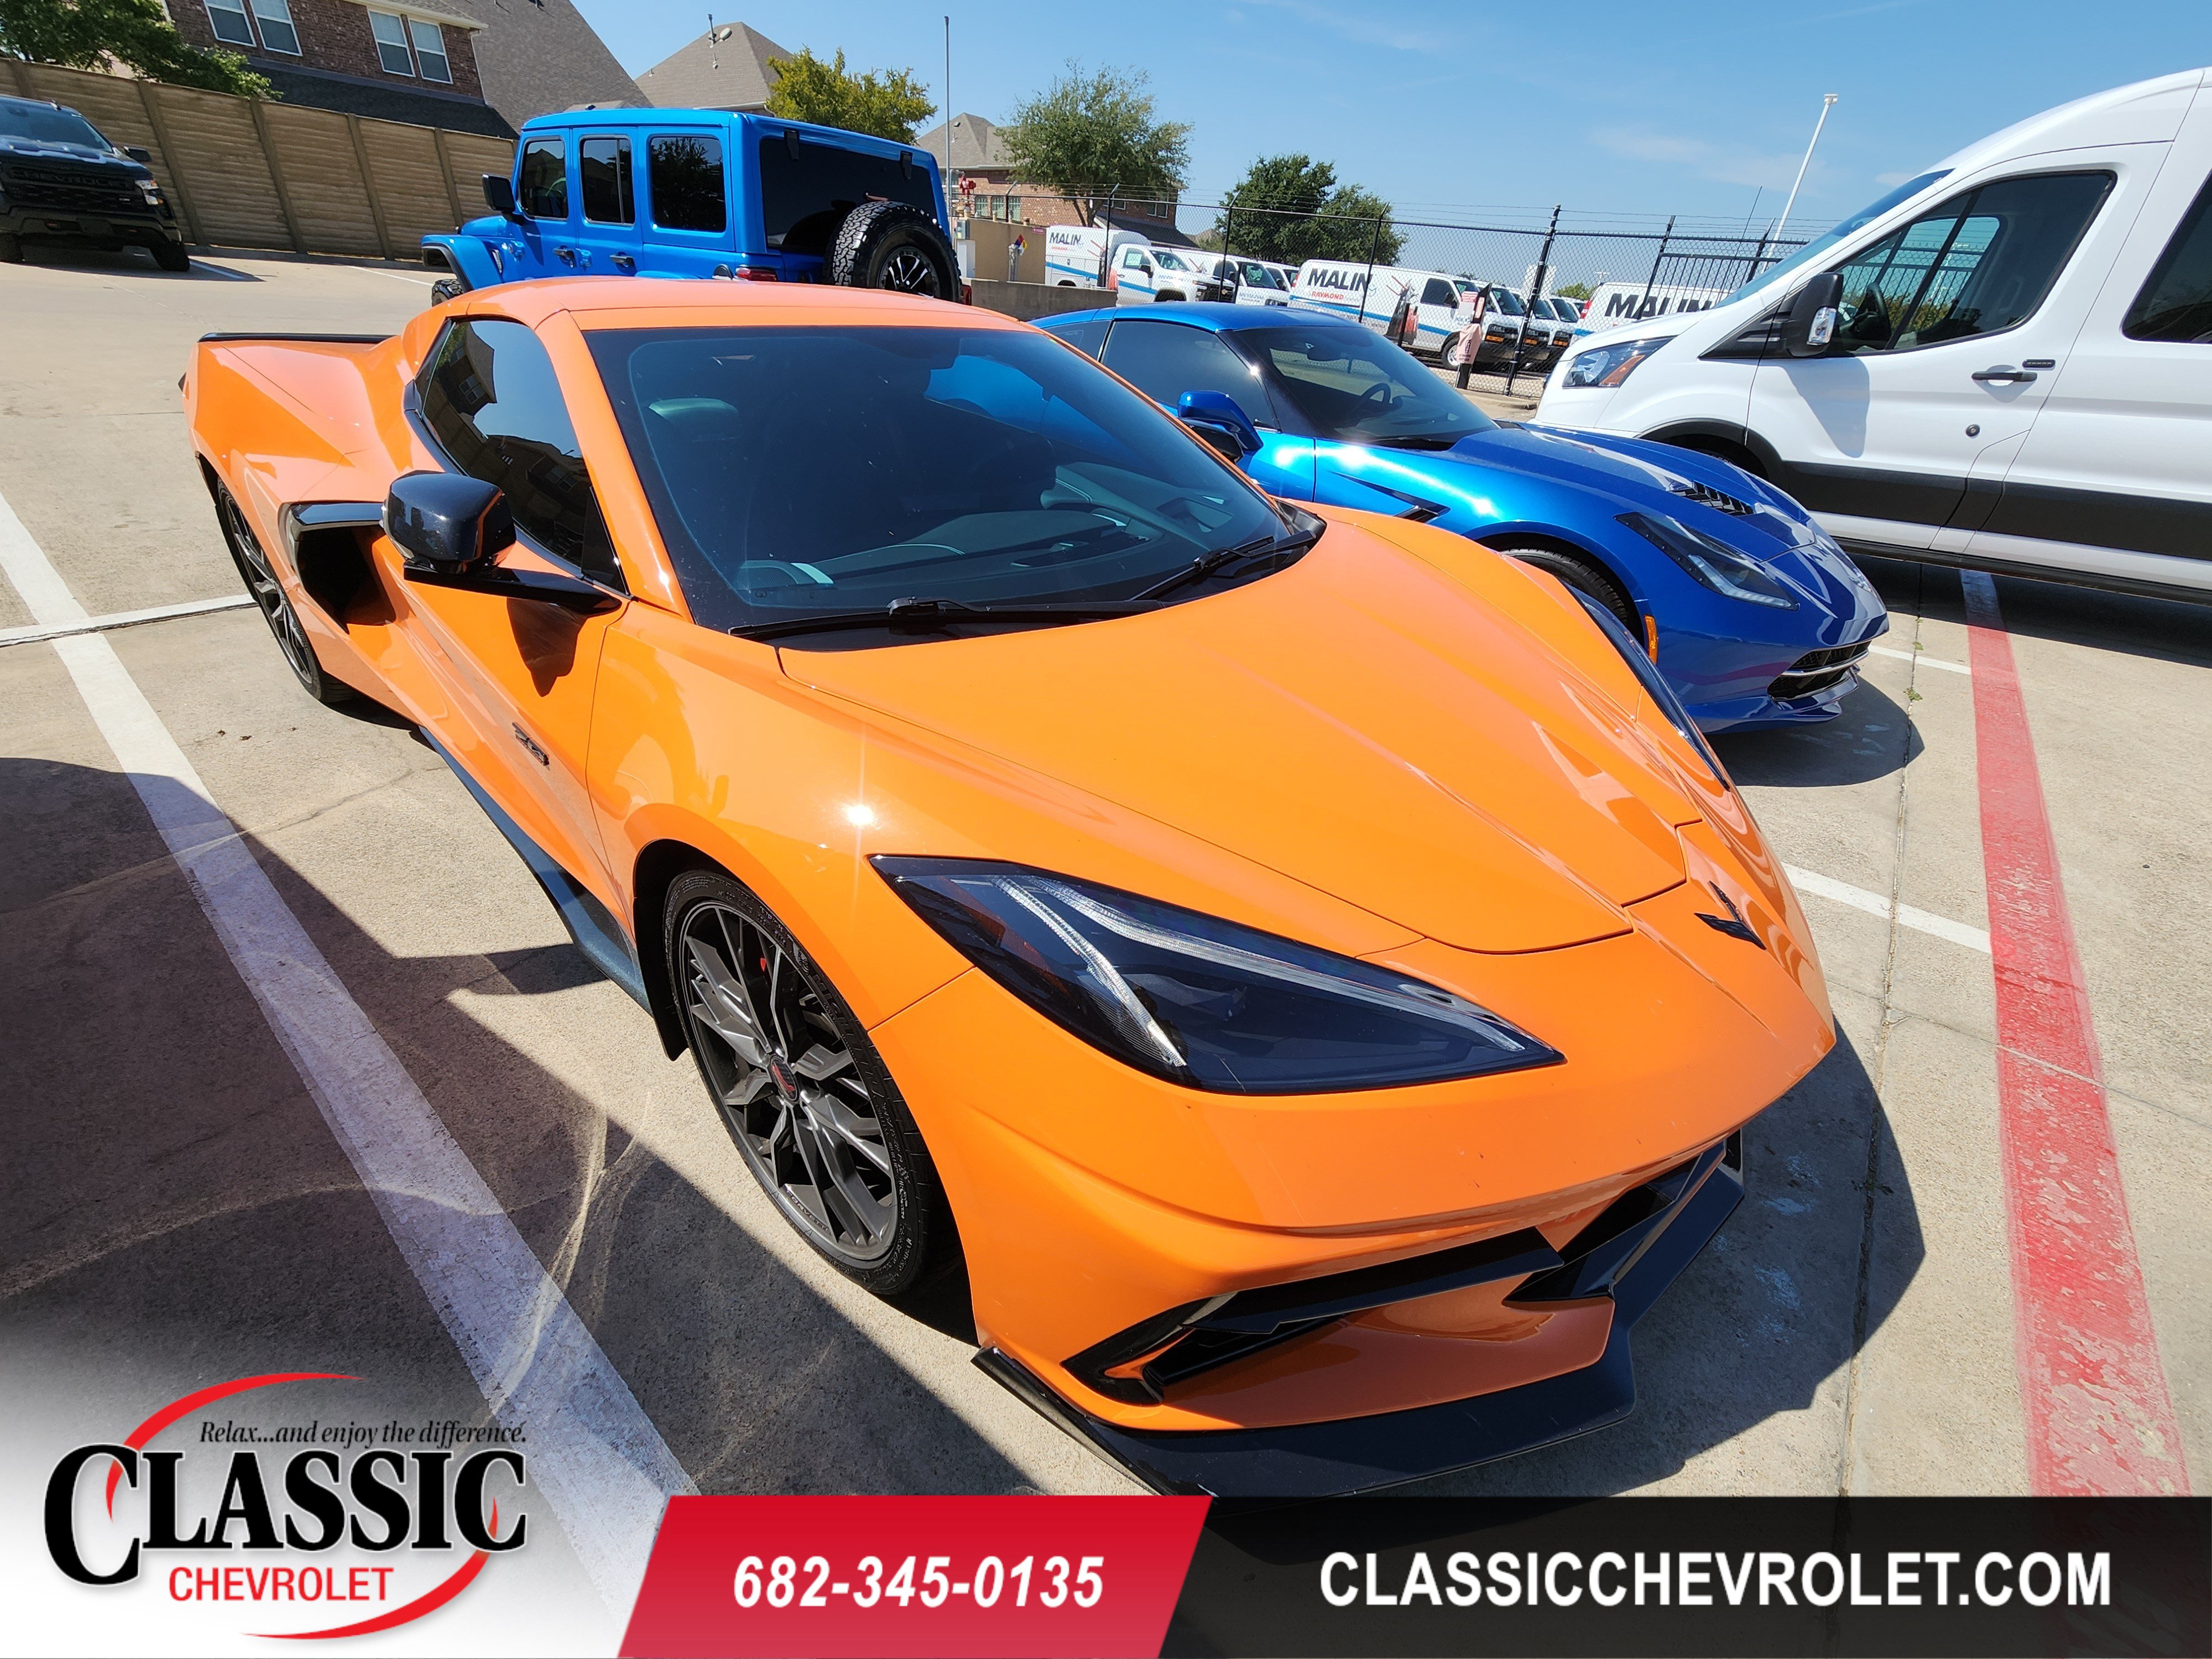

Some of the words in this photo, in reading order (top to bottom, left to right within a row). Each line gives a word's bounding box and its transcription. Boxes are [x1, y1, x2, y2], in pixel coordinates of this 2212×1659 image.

[1049, 232, 1082, 246] MALIN
[1307, 268, 1374, 293] MALIN
[1311, 291, 1344, 300] RAYMOND
